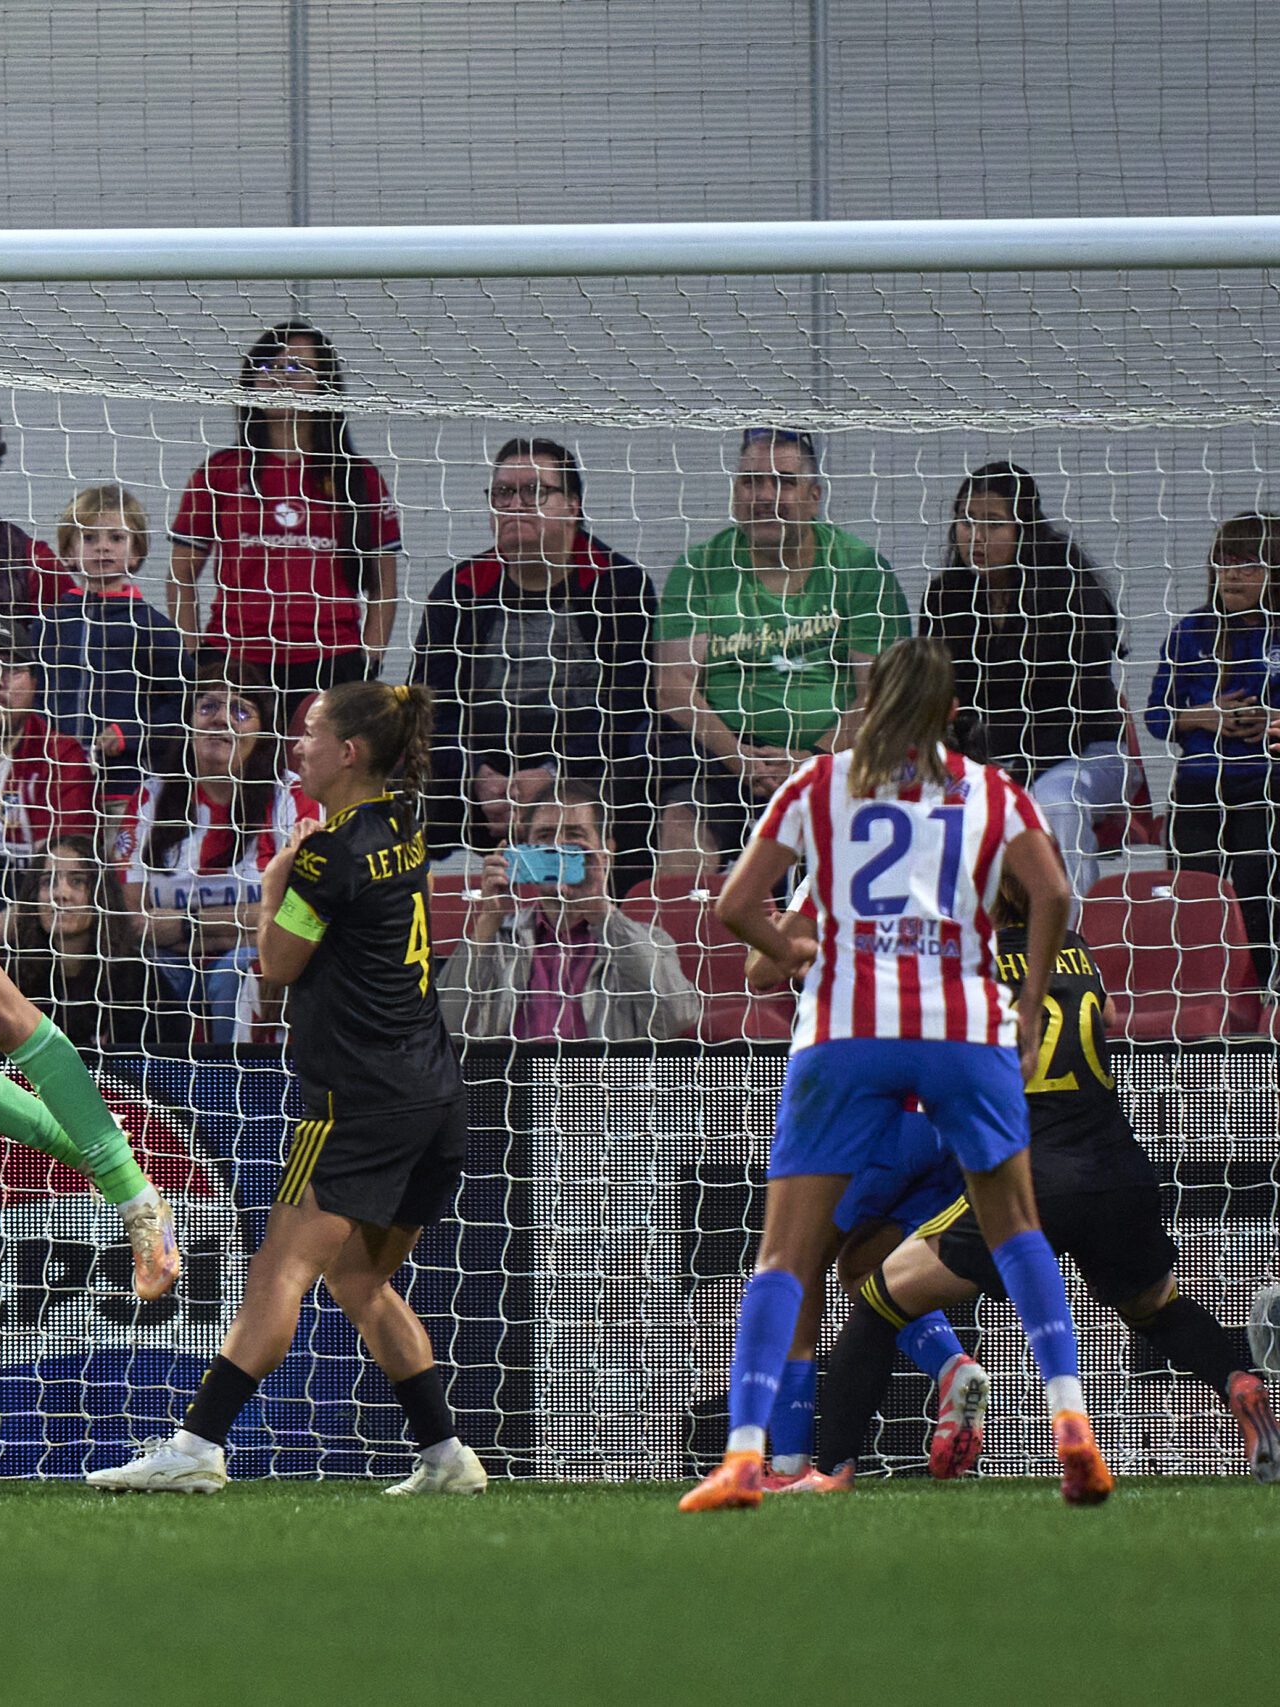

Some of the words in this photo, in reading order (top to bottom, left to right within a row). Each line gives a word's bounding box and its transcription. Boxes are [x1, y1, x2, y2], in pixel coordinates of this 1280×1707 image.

[366, 849, 392, 880] LE
[850, 803, 965, 918] 21
[403, 891, 431, 998] 4
[854, 935, 961, 957] RWANDA
[996, 948, 1094, 982] HIATA
